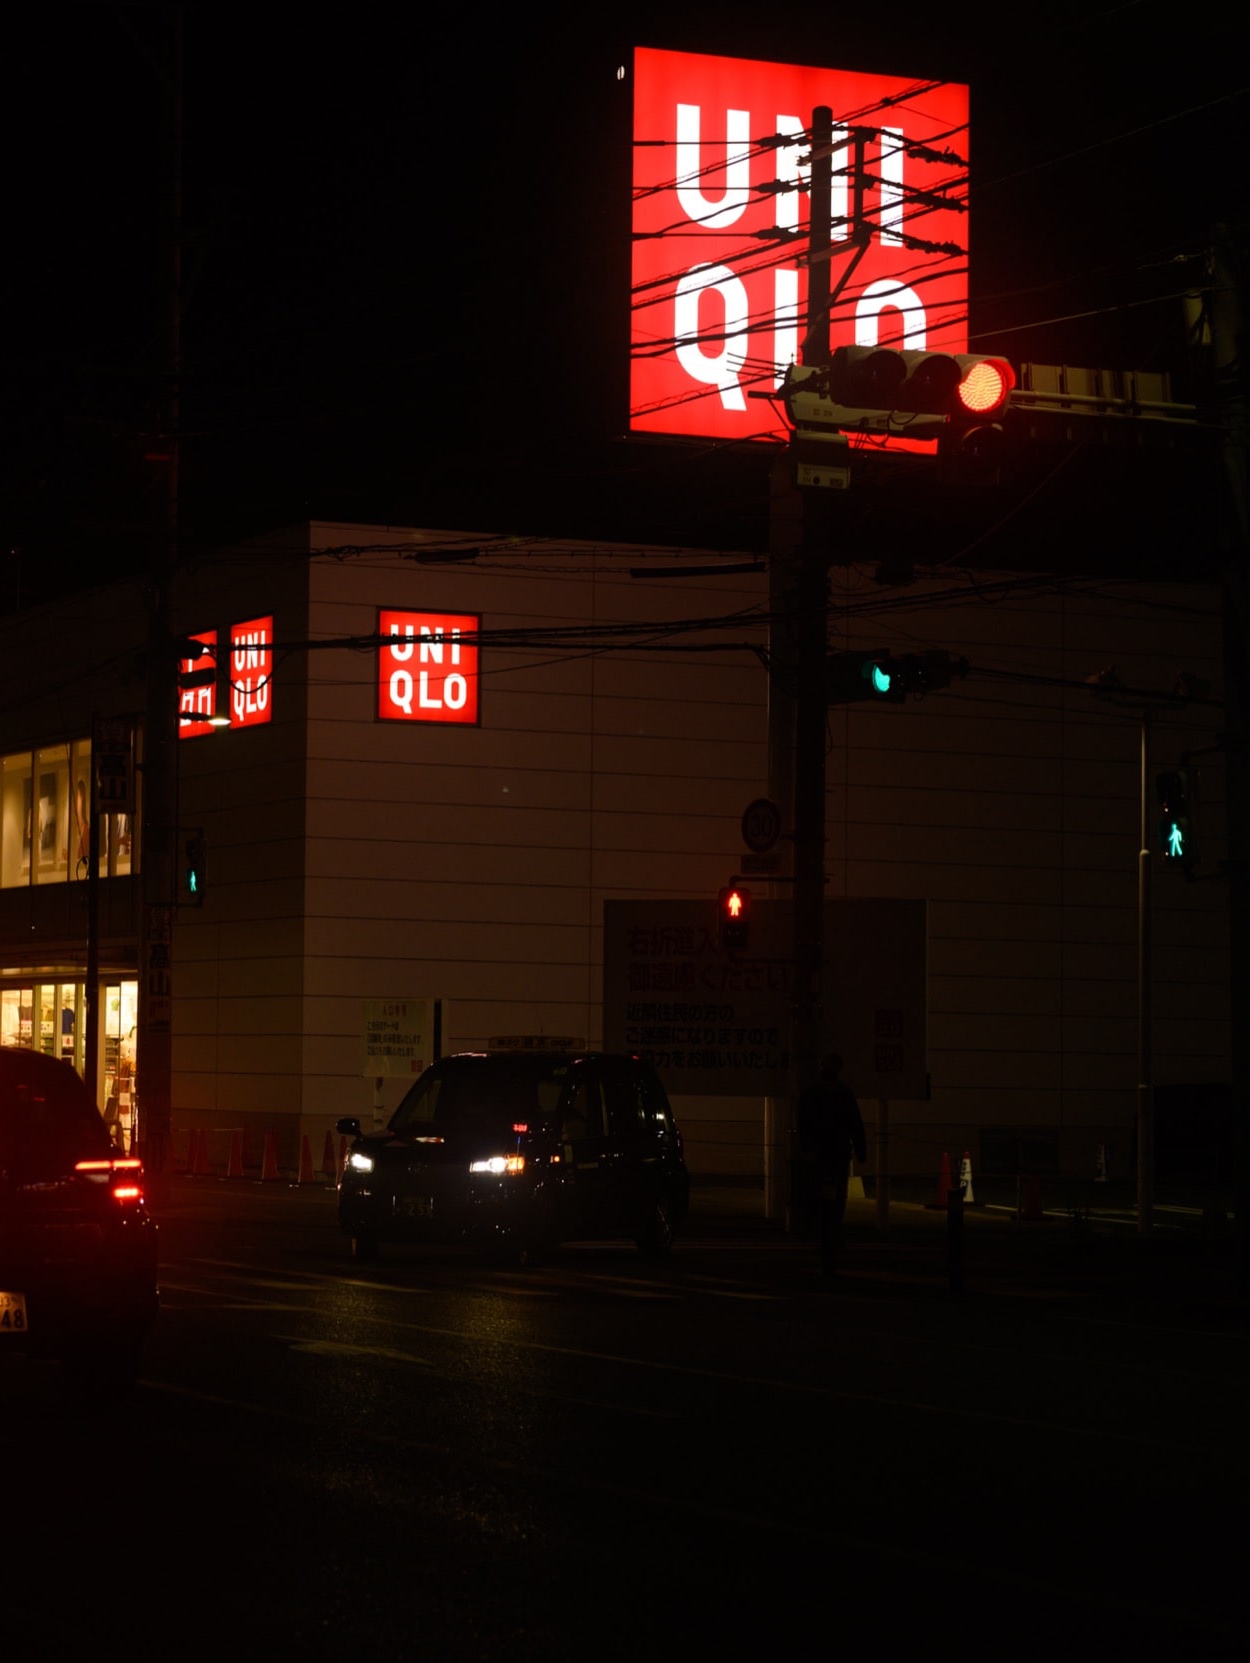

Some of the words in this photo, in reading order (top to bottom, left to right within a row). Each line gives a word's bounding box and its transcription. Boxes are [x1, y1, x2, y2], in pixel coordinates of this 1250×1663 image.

[676, 103, 904, 248] UNI
[234, 630, 266, 673] UNI
[390, 624, 461, 665] UNI
[234, 674, 268, 722] QLO
[389, 669, 468, 714] QLO
[627, 960, 790, 993] 御遠慮ください
